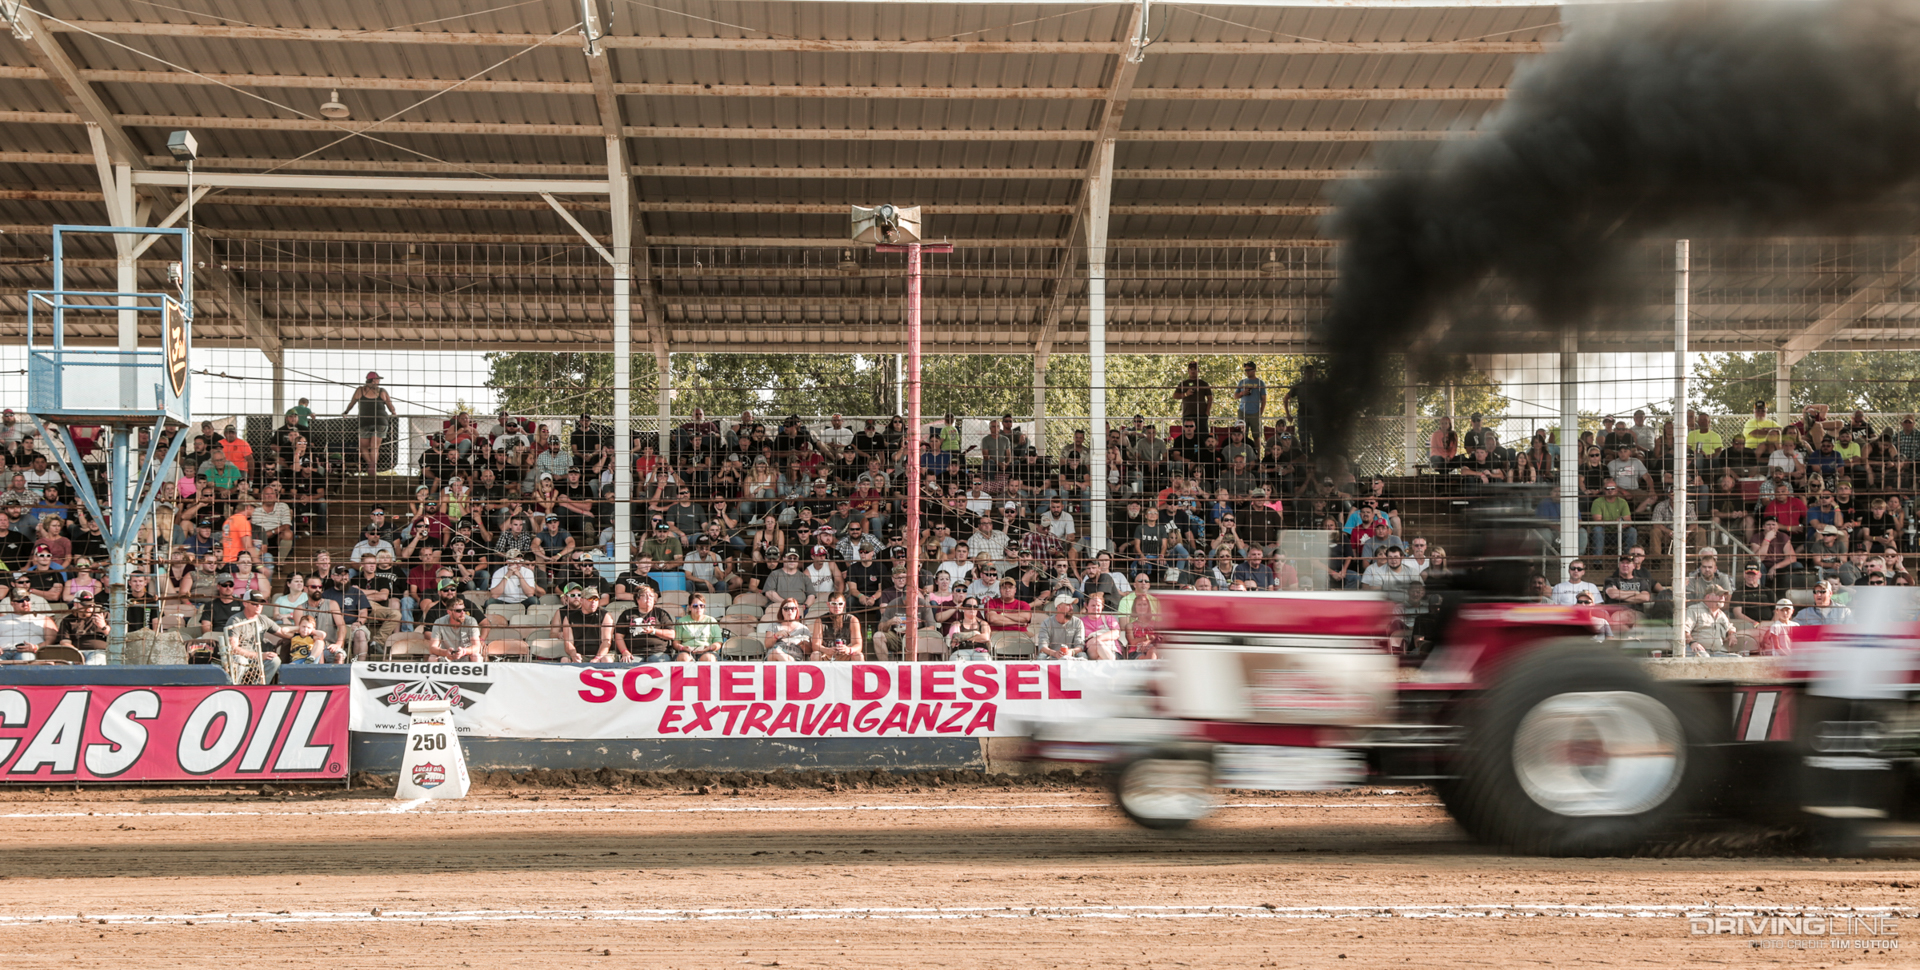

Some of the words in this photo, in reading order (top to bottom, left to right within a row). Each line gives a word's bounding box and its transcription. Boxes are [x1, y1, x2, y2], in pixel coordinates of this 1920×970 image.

[367, 662, 489, 676] scheiddiesel
[577, 664, 826, 704] SCHEID
[851, 663, 1082, 701] DIESEL
[657, 701, 998, 736] EXTRAVAGANZA
[412, 732, 447, 752] 250
[414, 765, 433, 773] LUCAS
